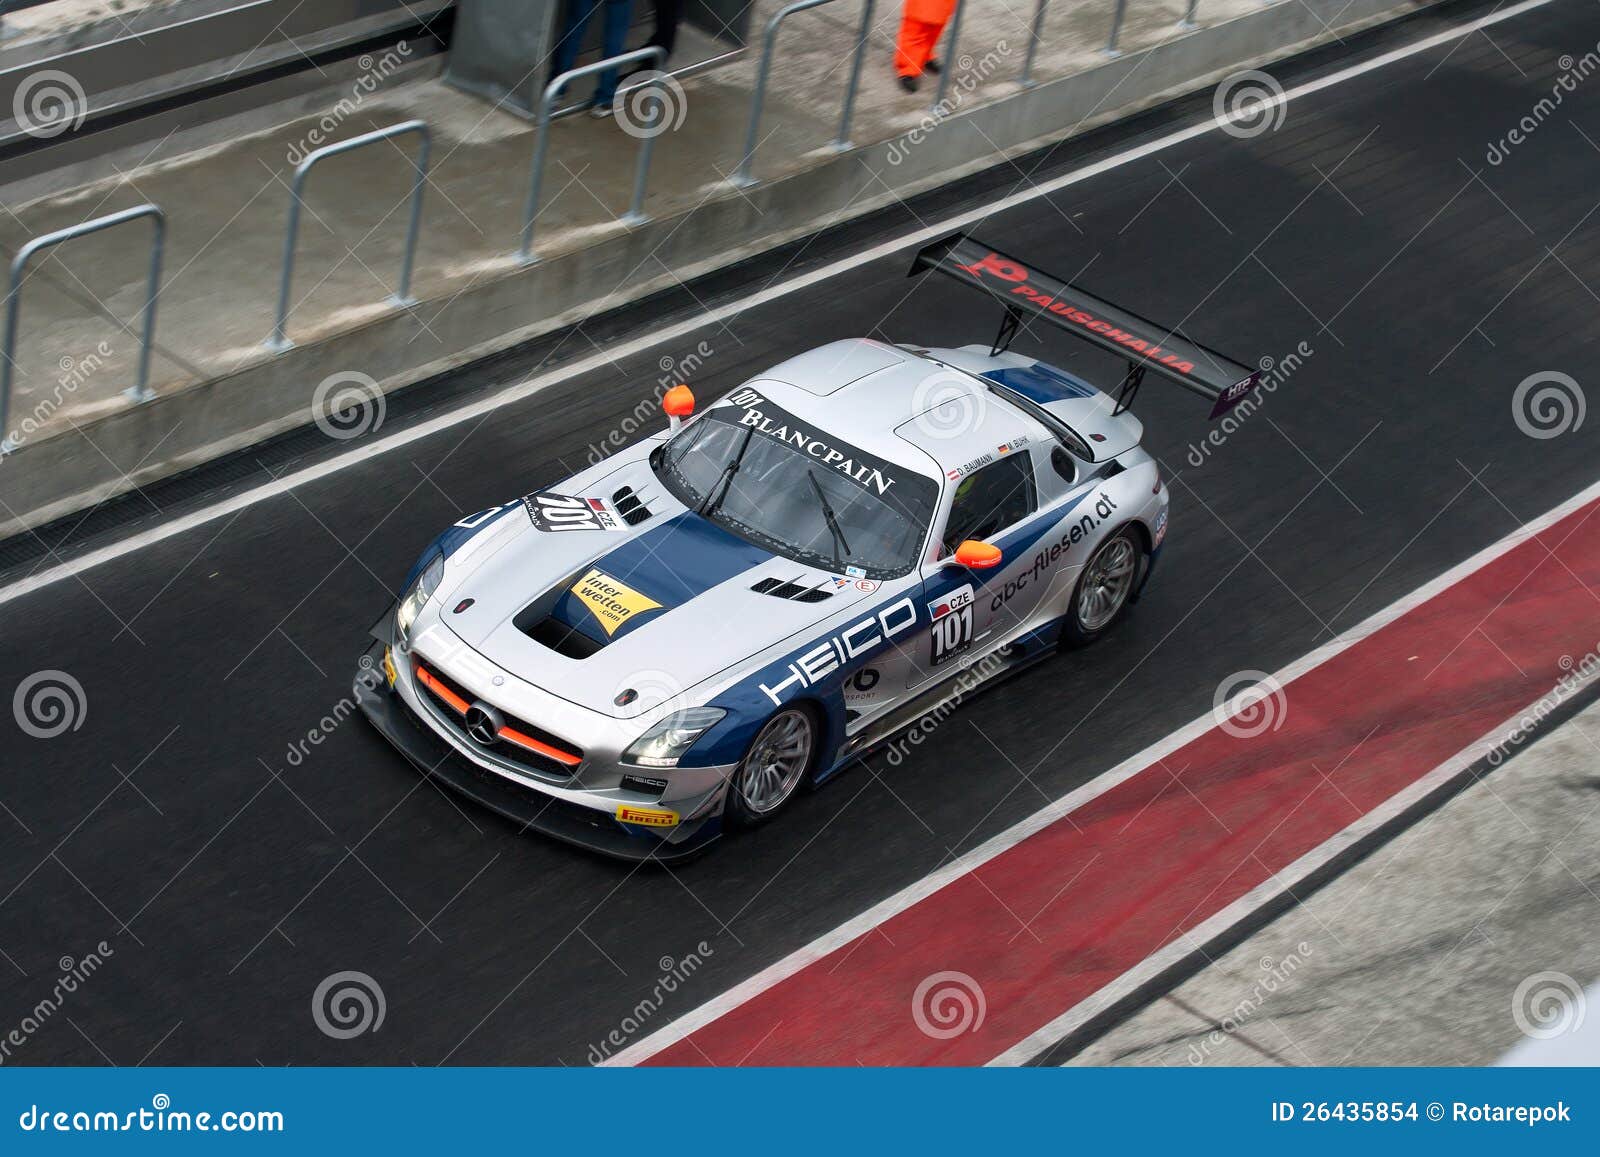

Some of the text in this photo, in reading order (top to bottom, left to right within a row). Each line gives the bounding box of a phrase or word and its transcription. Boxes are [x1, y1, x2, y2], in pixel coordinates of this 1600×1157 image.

[1008, 284, 1196, 374] PAUSCHALIA
[731, 388, 765, 410] 101
[737, 407, 896, 496] BLANCPAIN
[597, 511, 617, 528] CZE
[990, 491, 1118, 612] abc-fliesen.at
[580, 586, 631, 617] wetten
[950, 592, 970, 610] CZE
[931, 603, 974, 657] 101
[758, 596, 917, 707] HEICO
[624, 774, 667, 788] HEICO
[621, 809, 674, 825] PIRELLI
